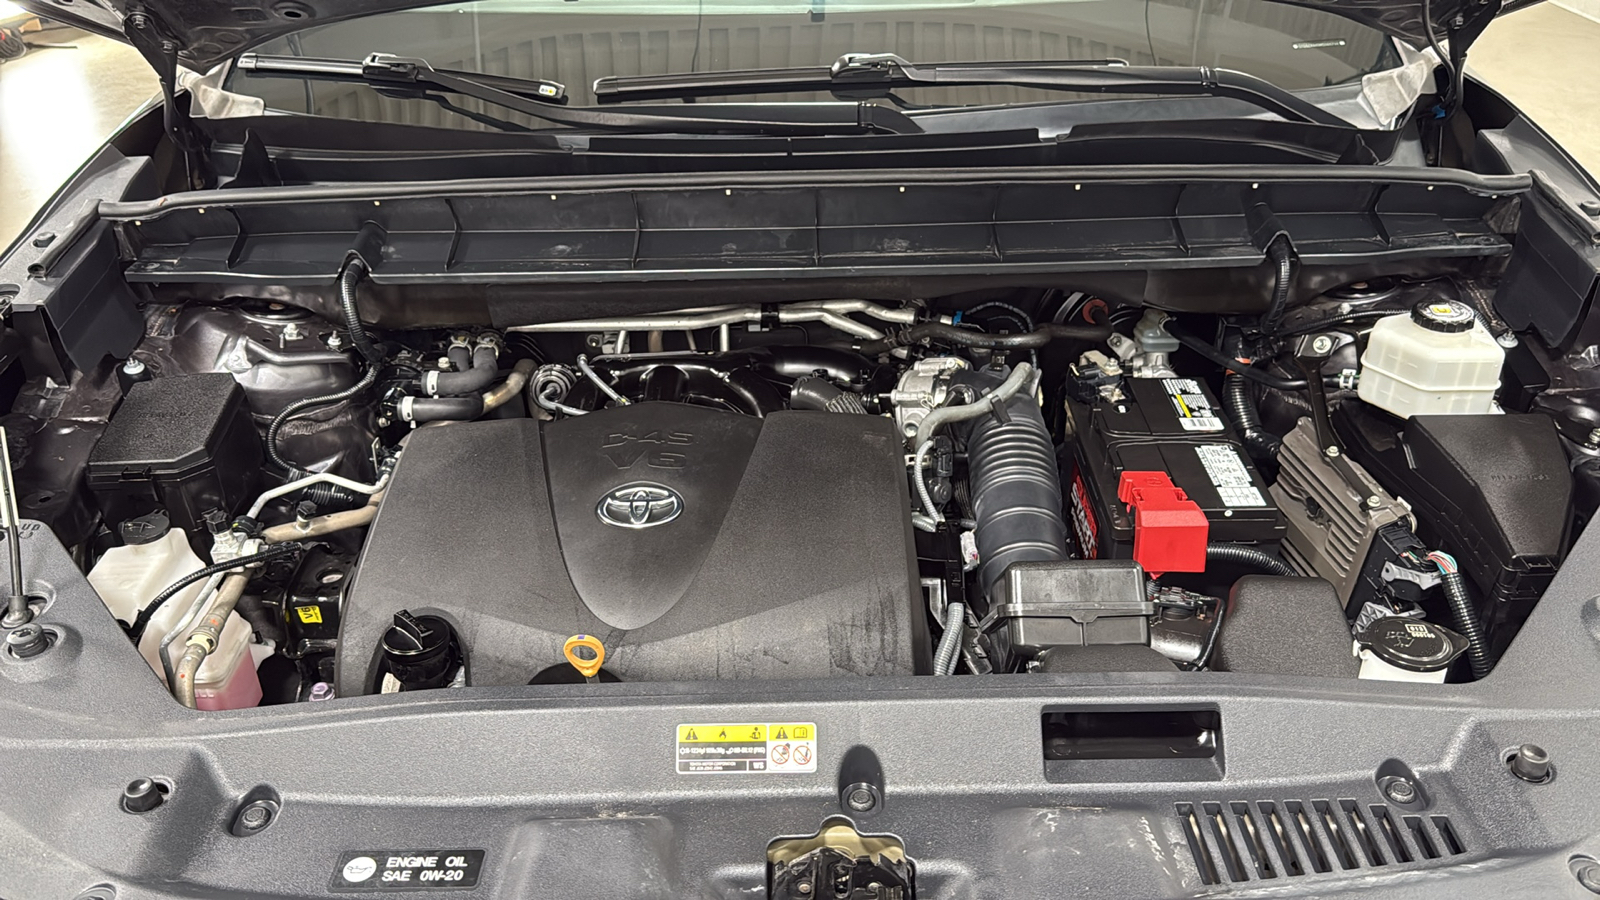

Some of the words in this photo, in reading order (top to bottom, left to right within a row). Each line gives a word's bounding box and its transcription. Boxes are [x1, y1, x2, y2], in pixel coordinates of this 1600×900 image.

[601, 429, 693, 449] D-4S
[602, 450, 687, 470] V6
[302, 606, 313, 619] V6
[386, 856, 438, 868] ENGINE
[445, 856, 468, 867] OIL
[381, 870, 412, 882] SAE
[419, 869, 464, 881] 0W-20
